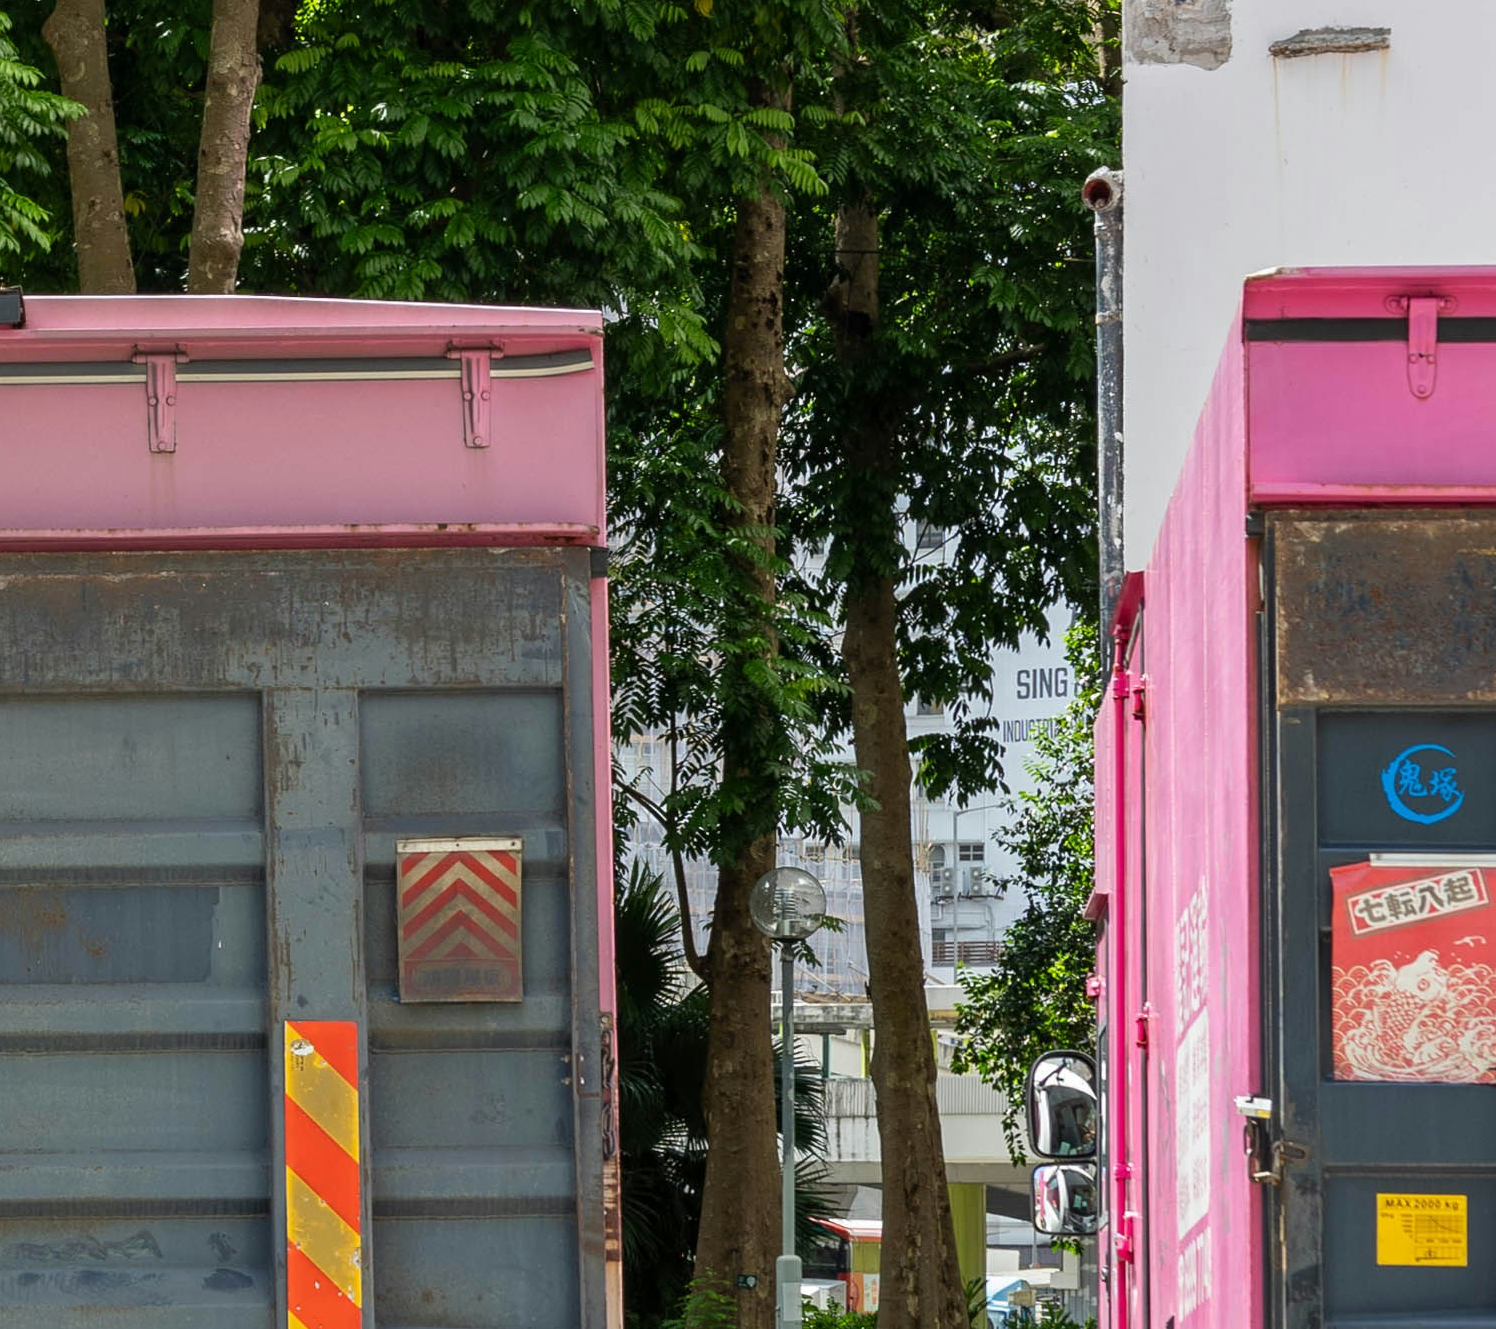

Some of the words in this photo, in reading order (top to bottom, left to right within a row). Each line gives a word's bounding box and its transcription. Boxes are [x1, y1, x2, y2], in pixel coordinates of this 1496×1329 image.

[1017, 667, 1068, 699] SING
[1398, 757, 1462, 802] 鬼塚
[1358, 875, 1475, 925] 七転八起
[1385, 1198, 1411, 1208] MAX
